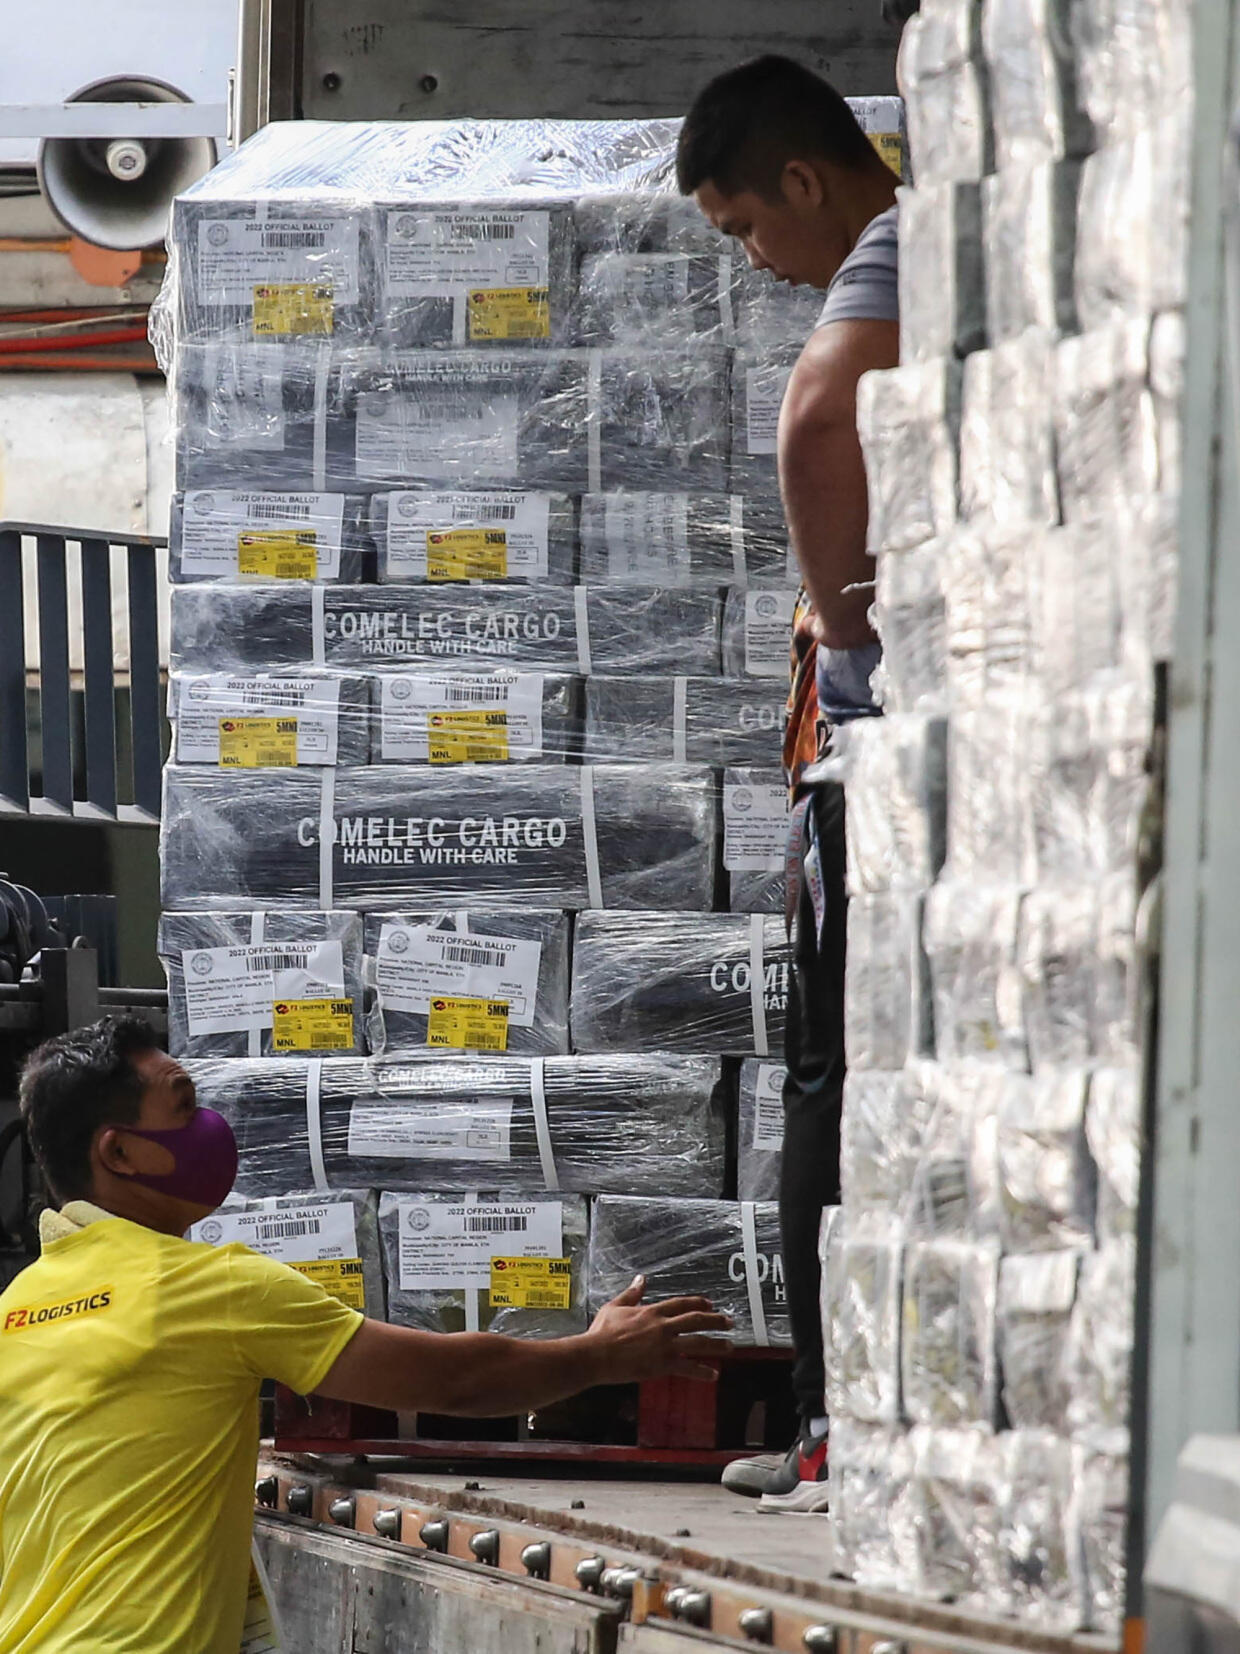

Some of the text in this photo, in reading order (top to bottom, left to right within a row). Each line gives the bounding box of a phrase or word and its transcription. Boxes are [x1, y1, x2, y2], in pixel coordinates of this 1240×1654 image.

[324, 612, 560, 639] COMELEC CARGO
[362, 640, 518, 654] HANDLE WITH CARE
[227, 682, 244, 690] 2022
[247, 682, 280, 690] OFFICIAL
[432, 750, 452, 759] MNL
[223, 756, 240, 764] MNL
[460, 817, 567, 847] CARGO
[343, 848, 518, 864] HANDLE WITH CARE
[426, 935, 517, 952] 2022 OFFICIAL BALLOT
[248, 946, 282, 955] OFFICIAL
[286, 945, 317, 953] BALLOT
[276, 1039, 296, 1047] MNL
[431, 1035, 450, 1044] MNL
[467, 1207, 503, 1215] OFFICIAL
[238, 1209, 328, 1225] 2022 OFFICIAL BALLOT
[493, 1294, 512, 1304] MNL
